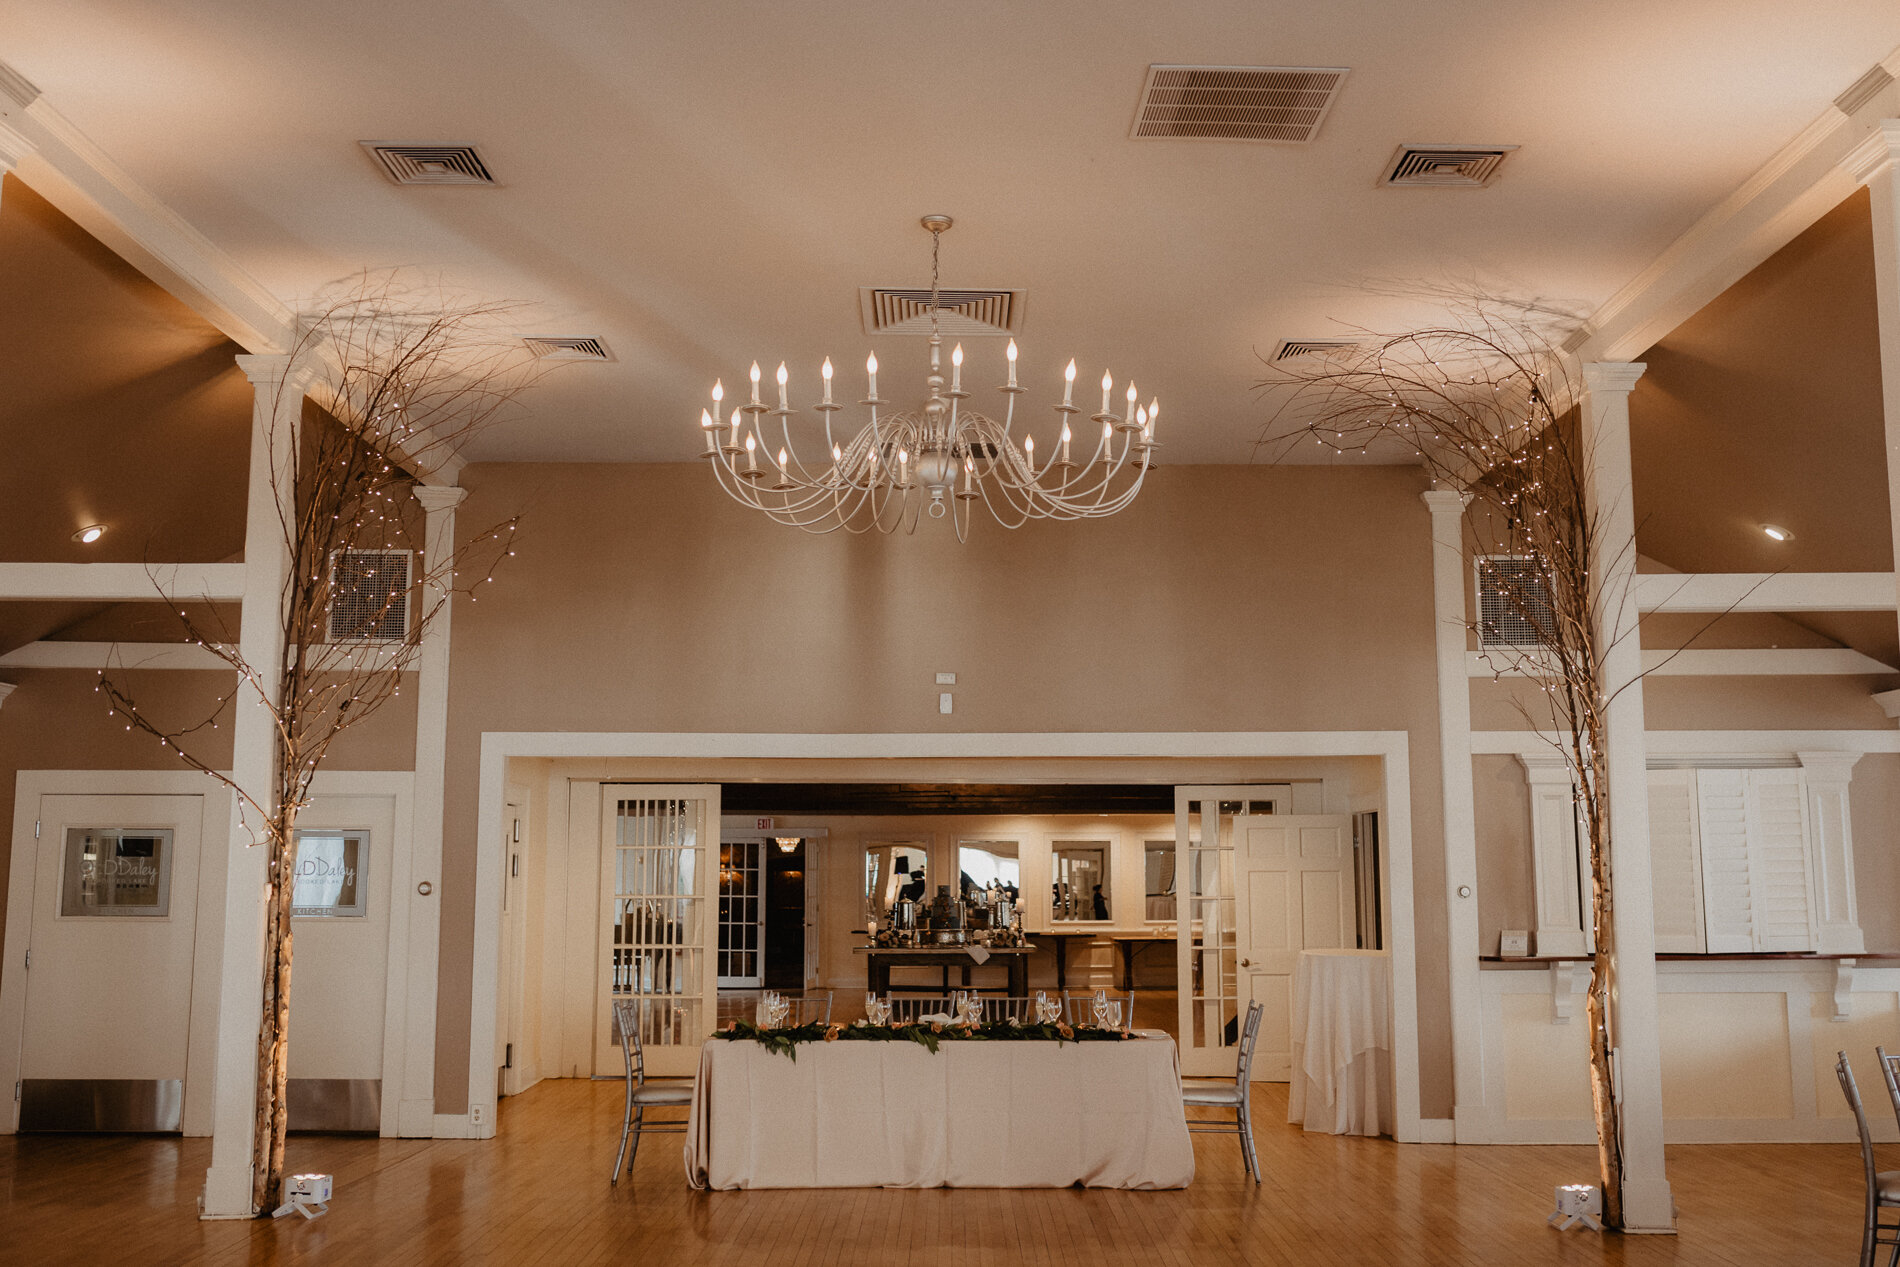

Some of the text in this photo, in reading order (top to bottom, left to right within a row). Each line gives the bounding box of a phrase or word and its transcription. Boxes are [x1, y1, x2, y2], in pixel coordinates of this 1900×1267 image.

[757, 818, 771, 829] EXIT
[117, 856, 158, 885] Daley
[315, 856, 356, 886] Daley
